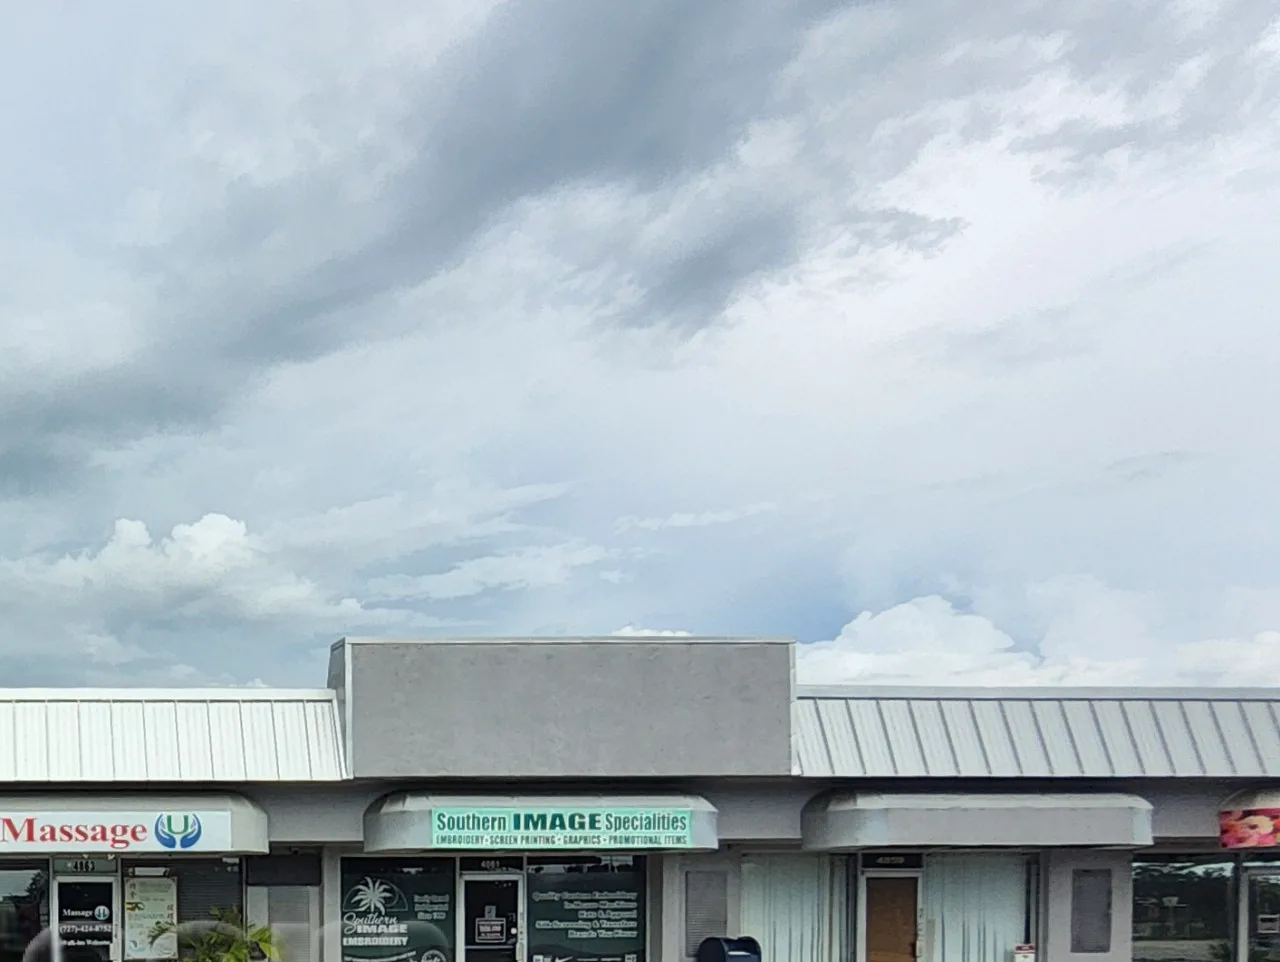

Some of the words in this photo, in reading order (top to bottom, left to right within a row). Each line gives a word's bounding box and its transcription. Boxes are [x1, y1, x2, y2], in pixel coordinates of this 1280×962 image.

[436, 812, 506, 831] Southern
[513, 812, 602, 831] IMAGE
[605, 812, 687, 832] Specialities
[0, 817, 148, 849] Massage
[436, 835, 484, 845] EMBROIDERY
[489, 835, 518, 845] SCREEN
[520, 835, 556, 845] PRINTING
[563, 835, 601, 845] GRAPHICS
[608, 835, 662, 845] PROMOTIONAL
[664, 835, 687, 845] ITEMS
[62, 909, 93, 917] Massage
[343, 912, 398, 934] Southern
[357, 924, 408, 933] IMAGE
[343, 936, 408, 946] EMBROIDERY
